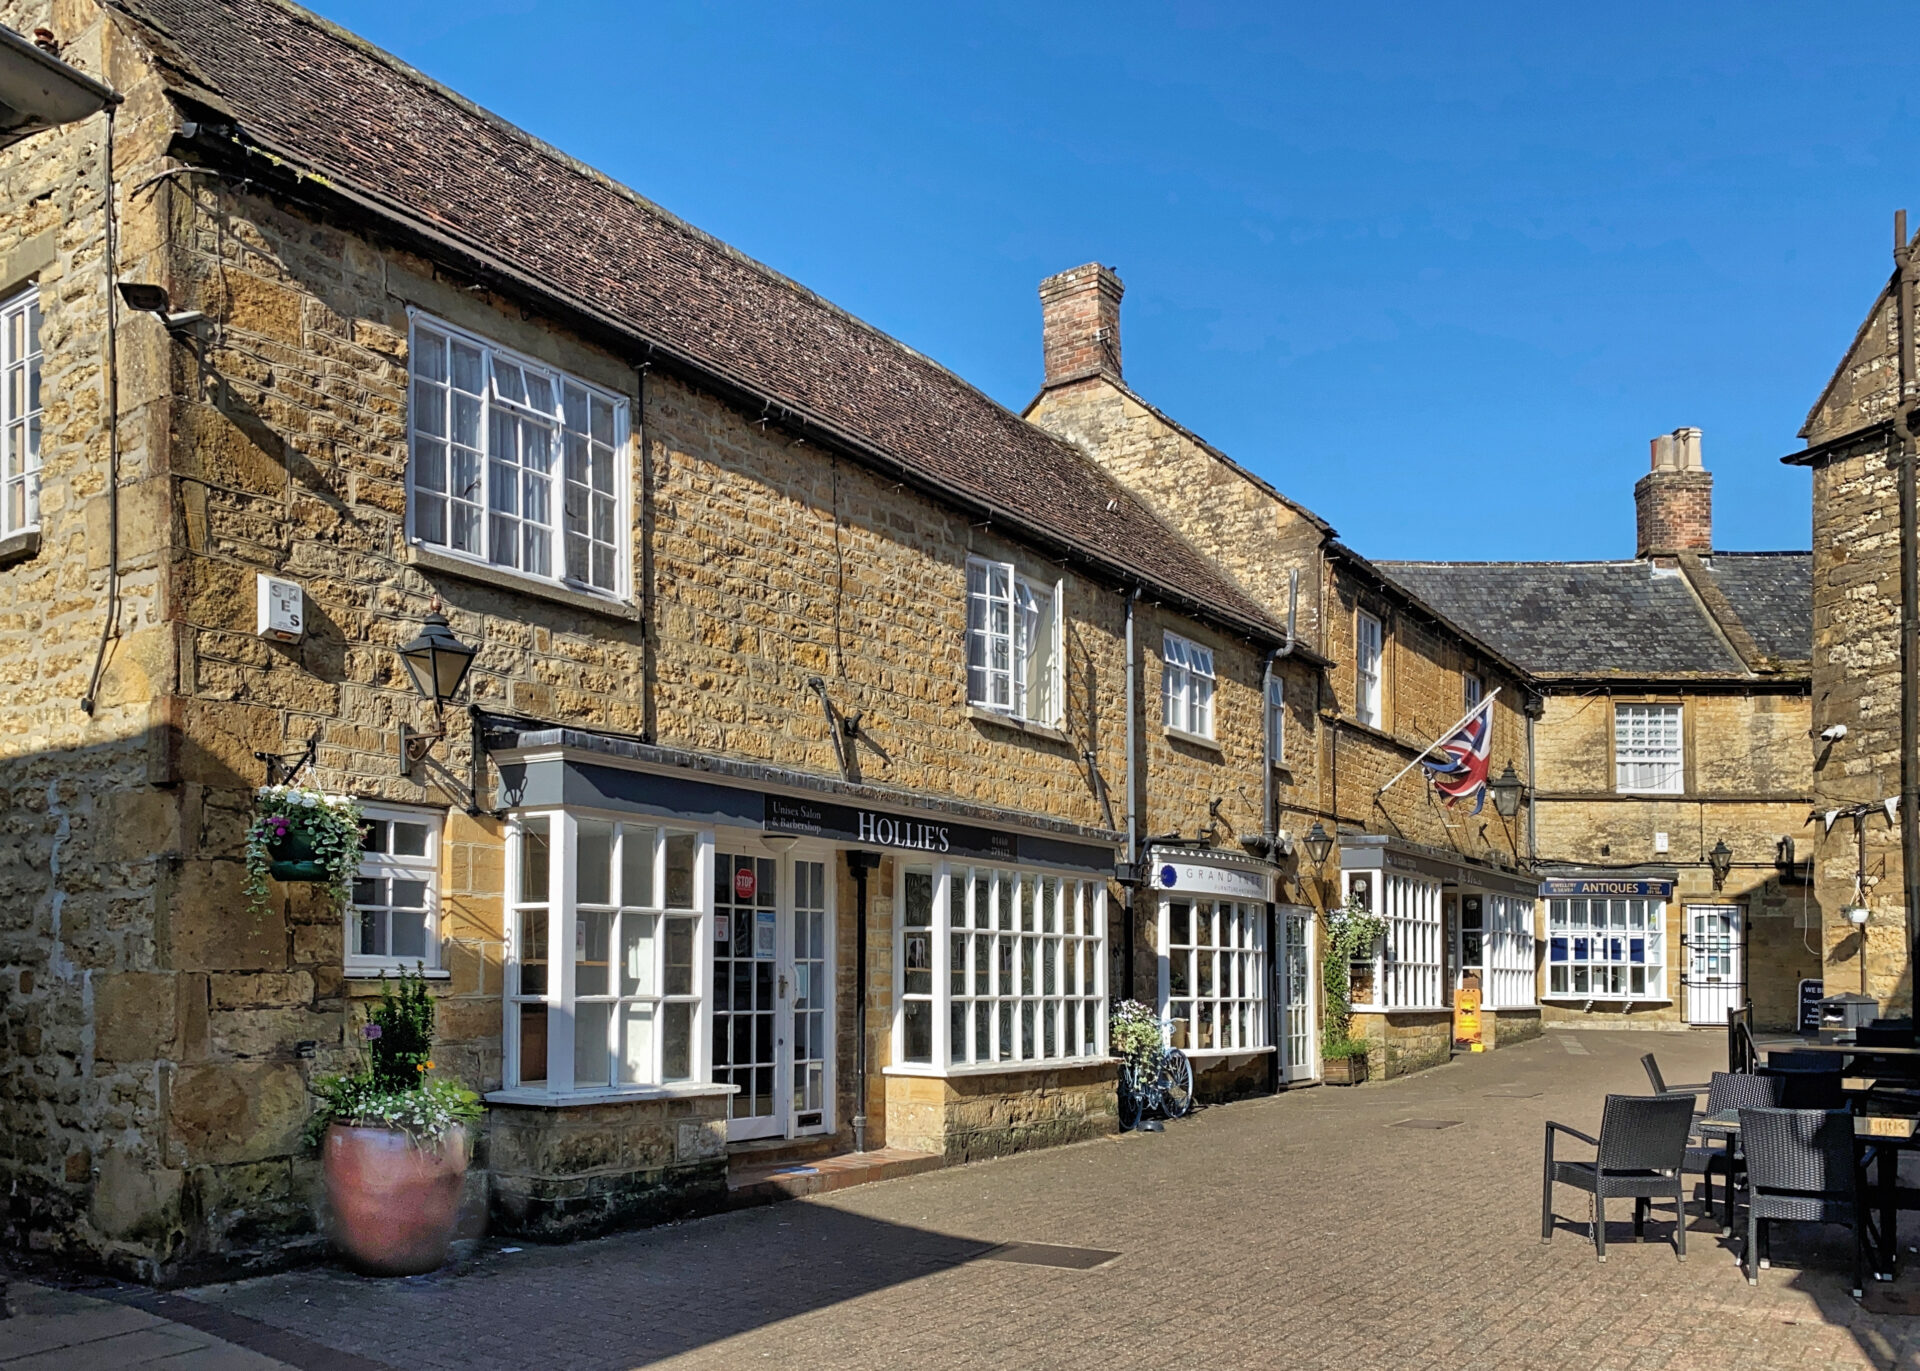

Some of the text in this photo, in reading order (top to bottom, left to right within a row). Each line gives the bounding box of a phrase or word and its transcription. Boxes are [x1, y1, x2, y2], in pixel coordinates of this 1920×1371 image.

[773, 801, 821, 819] Unisex Salon
[771, 817, 821, 835] & Barbershop
[857, 811, 950, 852] HOLLIE'S
[736, 875, 753, 888] STOP
[1186, 868, 1233, 883] GRAND
[1581, 882, 1639, 894] ANTIQUES
